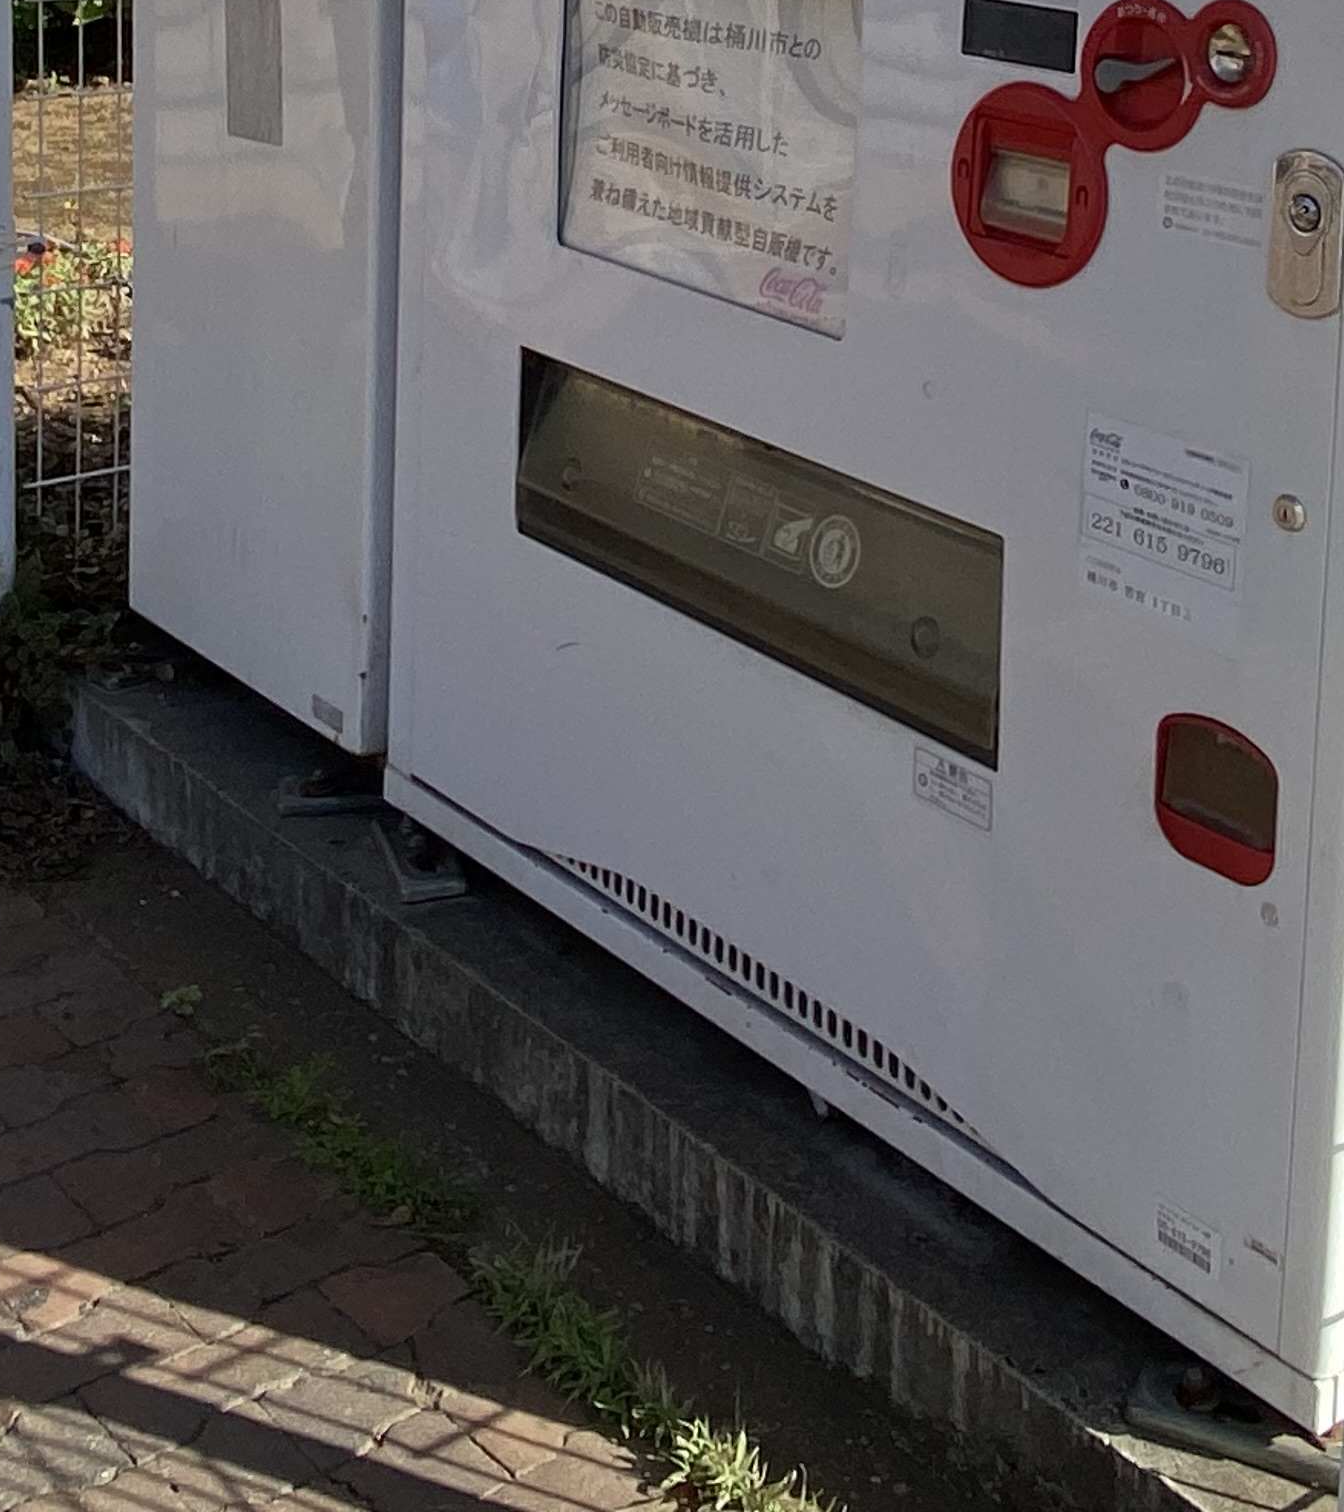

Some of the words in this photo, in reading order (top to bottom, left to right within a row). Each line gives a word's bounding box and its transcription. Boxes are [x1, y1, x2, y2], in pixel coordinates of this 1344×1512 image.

[594, 1, 822, 61] この自動販売機は桶川市との
[598, 43, 727, 98] 防災協定に基づき、
[599, 91, 789, 158] メッセージボードを活用した
[595, 134, 838, 223] ご利用者向け情報提供システムを
[1133, 484, 1166, 506] 0800
[1091, 512, 1122, 539] 221
[1133, 529, 1168, 555] 615
